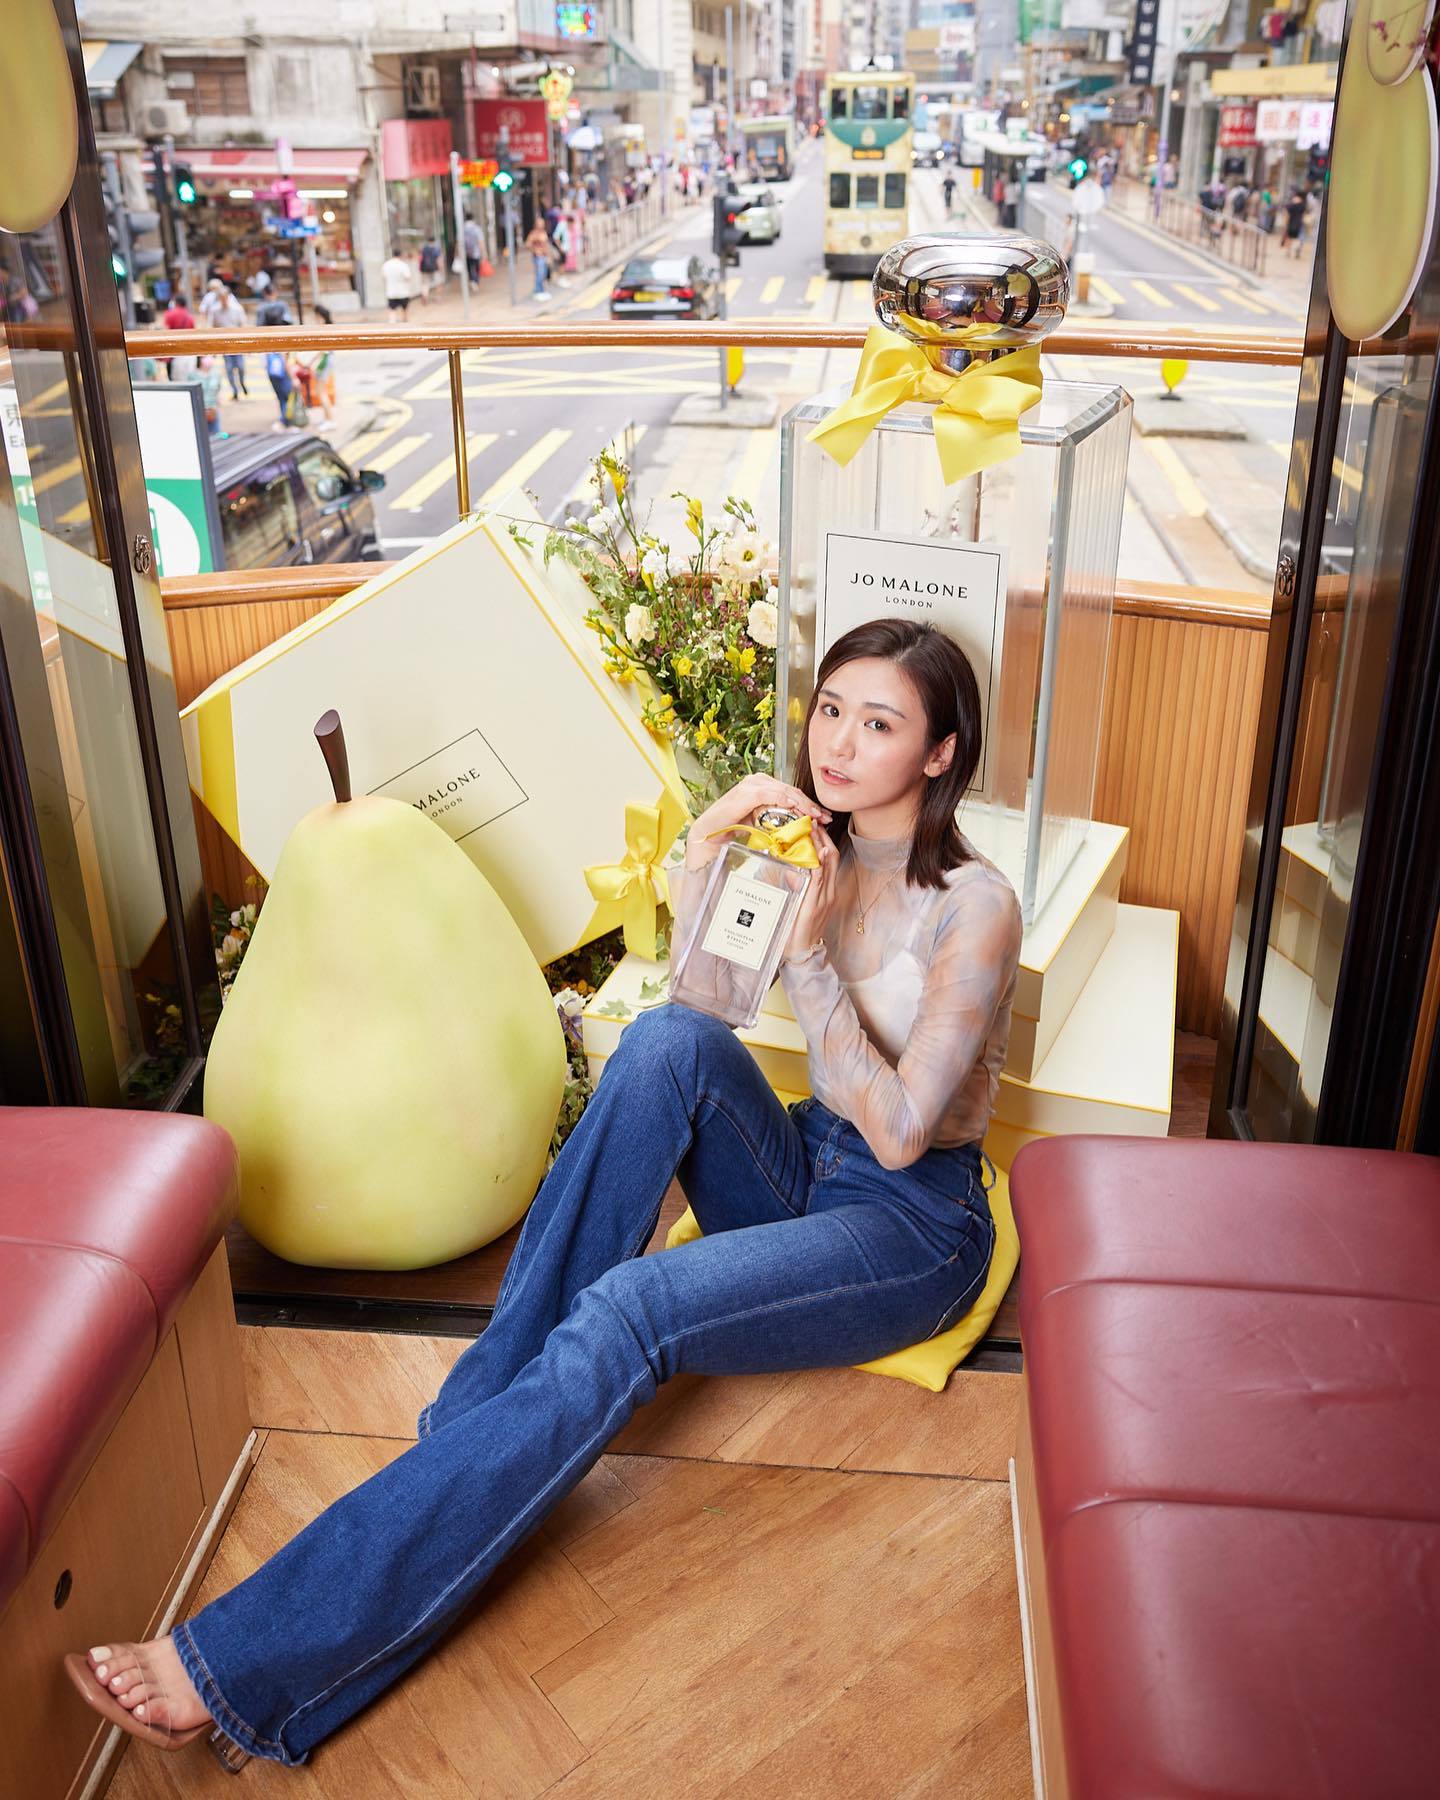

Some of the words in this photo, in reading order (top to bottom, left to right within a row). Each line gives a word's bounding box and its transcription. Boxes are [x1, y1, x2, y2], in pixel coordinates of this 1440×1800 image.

[850, 572, 875, 587] JO
[881, 576, 969, 600] MALONE
[885, 596, 933, 609] LONDON
[431, 797, 463, 819] ONDON
[745, 890, 772, 906] MALONE
